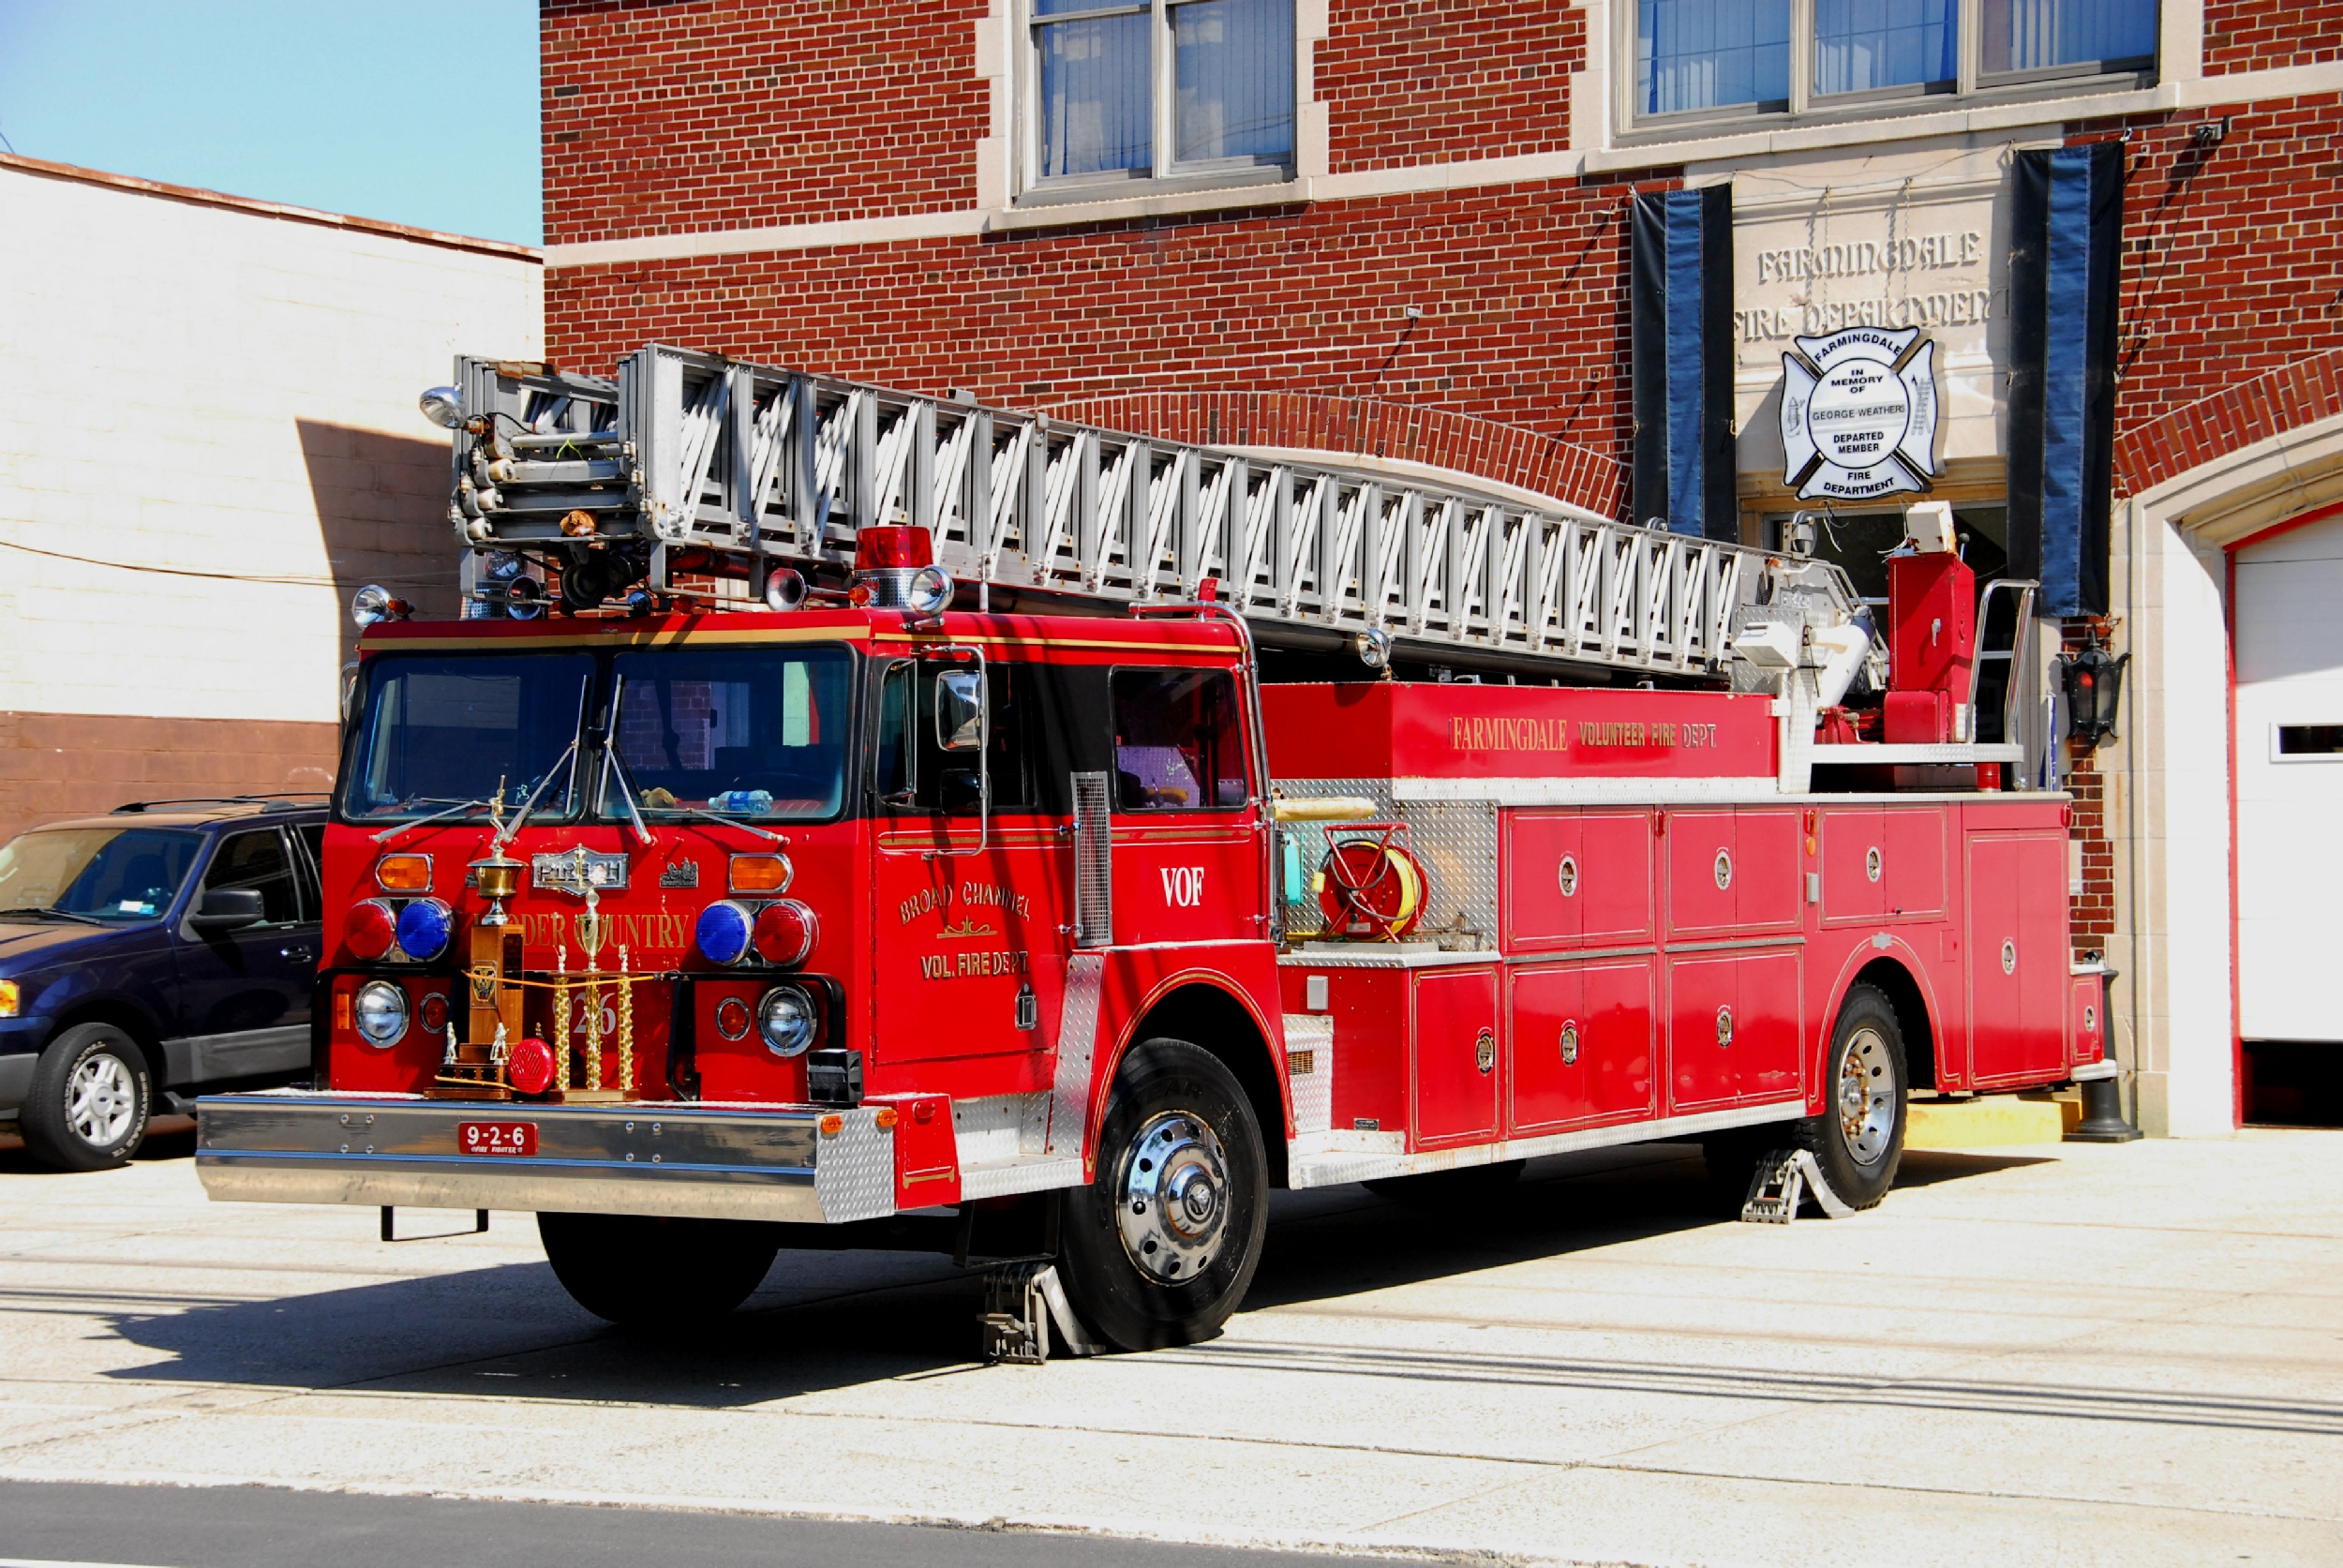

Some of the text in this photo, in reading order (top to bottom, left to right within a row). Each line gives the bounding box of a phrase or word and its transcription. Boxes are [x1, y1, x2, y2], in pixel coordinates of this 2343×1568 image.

[1758, 231, 1983, 284] FARMINGDALE
[1814, 333, 1903, 363] FARMINGDALE
[1830, 376, 1884, 386] MEMORY
[1833, 431, 1885, 443] DEPARTED
[1838, 443, 1880, 454] MEMBER
[1823, 477, 1895, 495] DEPARTMENT
[1847, 471, 1871, 481] FIRE
[1453, 717, 1568, 751] FARMINGDALE
[1578, 722, 1645, 747] VOLUNTEER
[1650, 723, 1676, 748] FIRE
[1160, 867, 1204, 907] VOF
[900, 881, 1030, 925] BROAD CHANNEL
[574, 913, 690, 948] UNTRY
[921, 955, 954, 978] VOL.
[957, 952, 990, 977] FIRE
[468, 1127, 525, 1145] 9-2-6
